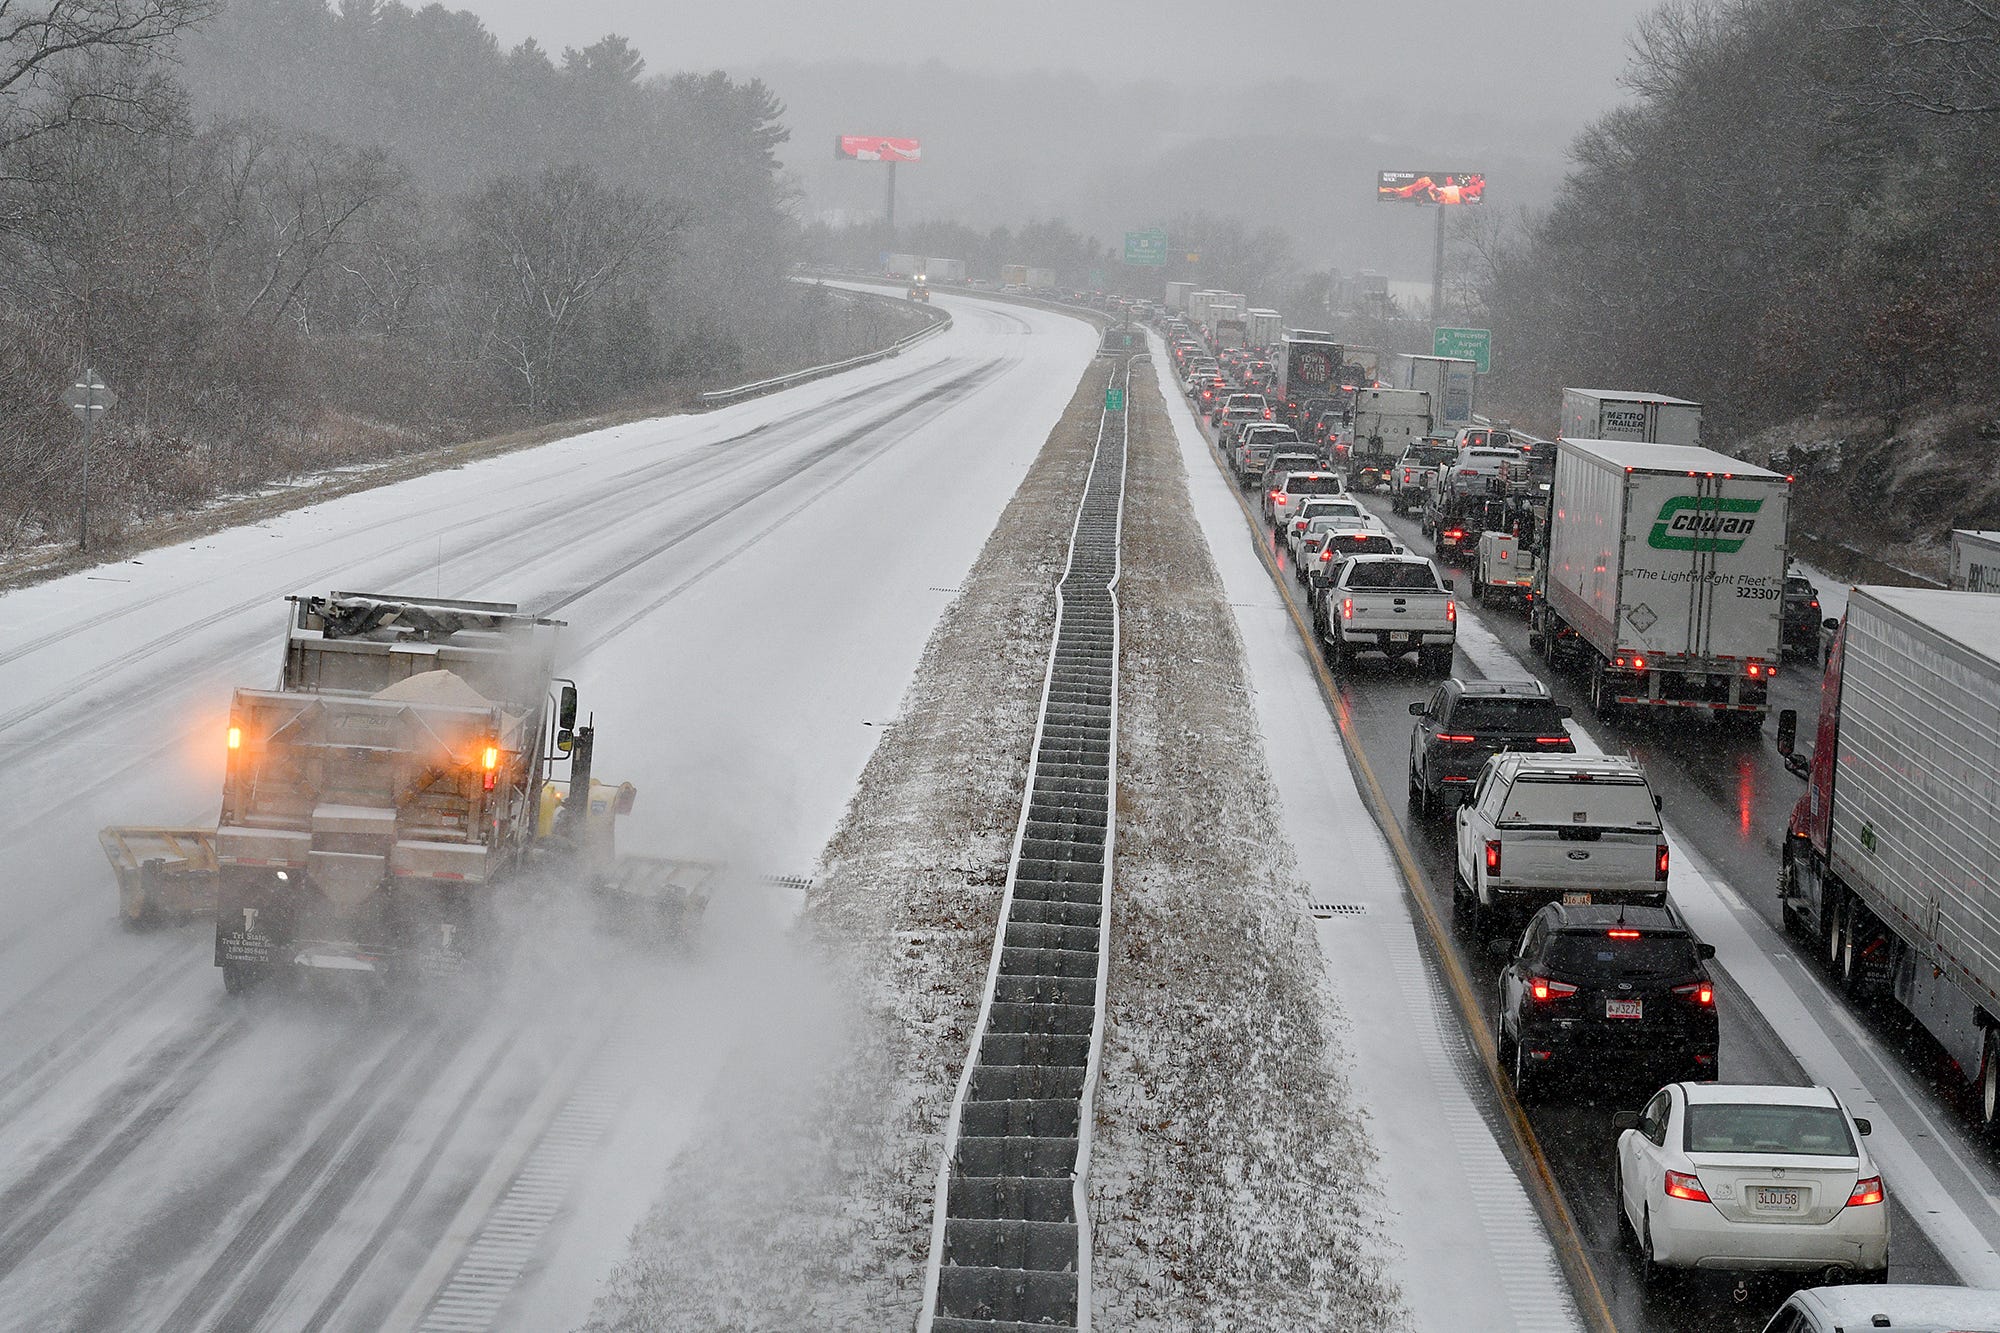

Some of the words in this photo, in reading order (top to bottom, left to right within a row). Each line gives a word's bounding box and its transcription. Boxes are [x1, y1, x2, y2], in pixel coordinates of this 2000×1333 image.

[1301, 355, 1325, 364] TOWN
[1303, 363, 1325, 373] FAIR
[1607, 411, 1644, 420] METRO
[1608, 420, 1644, 428] TRAILER
[1633, 568, 1657, 580] "The
[1737, 575, 1772, 587] Fleet"
[1736, 587, 1781, 601] 323307
[232, 931, 244, 939] Tri
